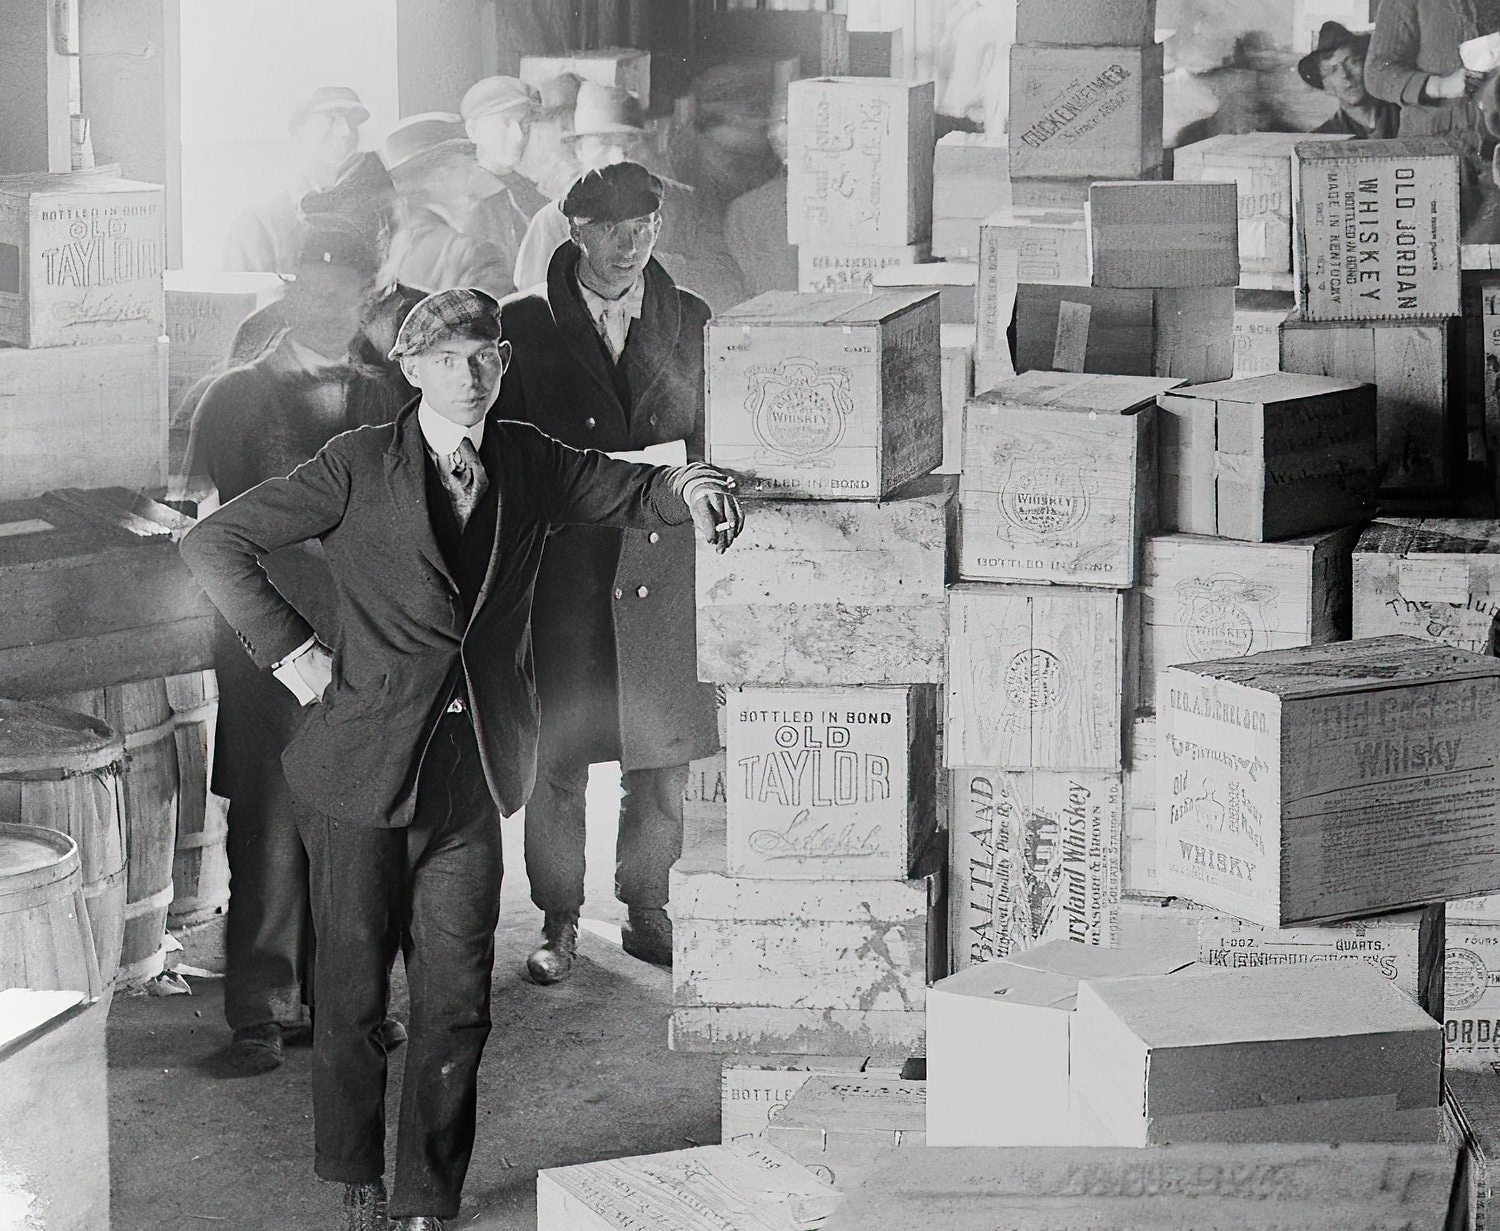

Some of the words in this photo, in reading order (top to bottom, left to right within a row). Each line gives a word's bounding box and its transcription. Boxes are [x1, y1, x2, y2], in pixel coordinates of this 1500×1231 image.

[1395, 168, 1415, 209] OLD
[70, 217, 127, 240] OLD
[1358, 177, 1381, 301] WHISKEY
[41, 237, 157, 287] TAYLOR
[1329, 234, 1342, 305] KENTUCKY
[1396, 219, 1418, 309] JORDAN
[807, 479, 823, 490] IN
[830, 478, 870, 490] BOND
[1016, 492, 1072, 507] WHISKEY
[977, 556, 1044, 569] BOTTLED
[739, 710, 814, 724] BOTTLED
[821, 711, 839, 724] IN
[846, 711, 892, 725] BOND
[774, 725, 852, 749] OLD
[738, 749, 891, 808] TAYLOR
[996, 820, 1010, 854] Pure
[1062, 780, 1092, 864] Whiskey
[1089, 805, 1101, 858] BROWN
[1088, 860, 1101, 873] &
[1178, 839, 1257, 881] WHISKY
[996, 857, 1013, 904] Quality
[1335, 938, 1386, 952] QUARTS.
[731, 1087, 793, 1102] BOTTLE
